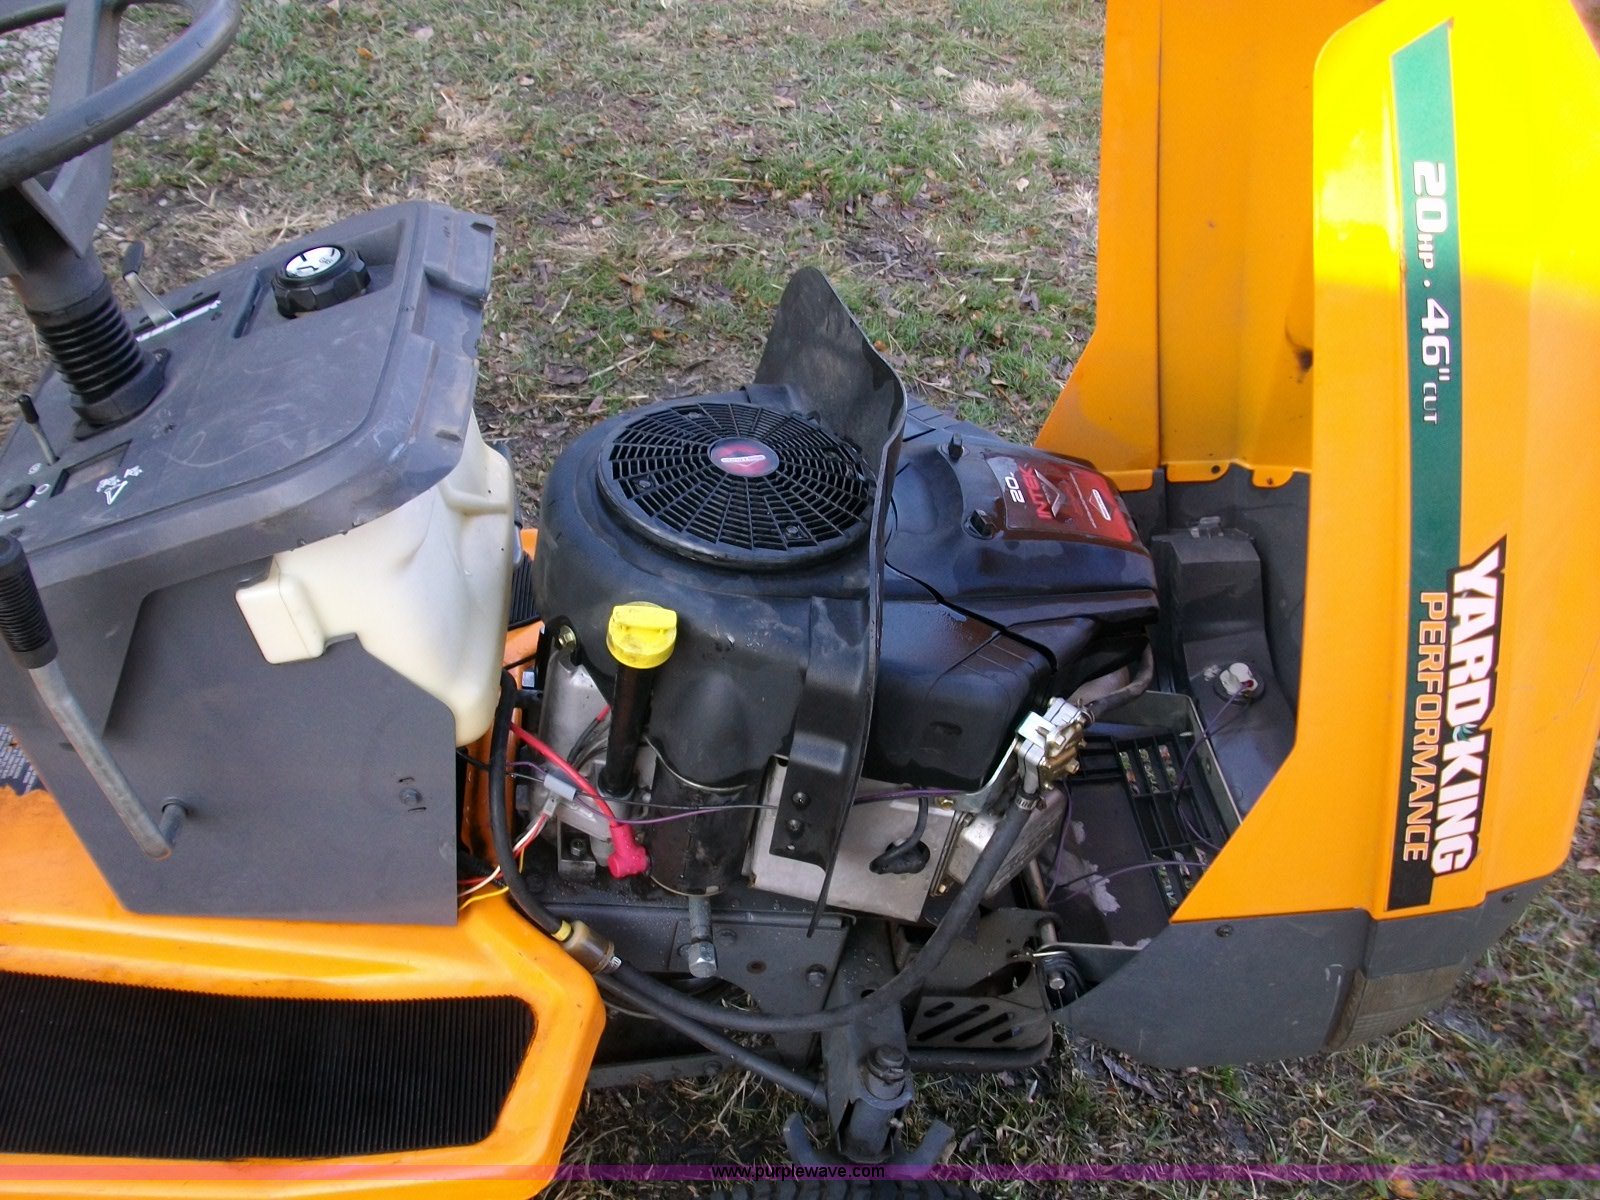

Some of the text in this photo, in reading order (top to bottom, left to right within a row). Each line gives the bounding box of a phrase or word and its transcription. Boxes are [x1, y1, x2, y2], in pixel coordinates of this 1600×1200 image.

[1423, 382, 1438, 425] CUT
[1018, 464, 1053, 520] INTEK
[1404, 592, 1447, 862] PERFORMANCE
[1431, 546, 1501, 874] YARD KING
